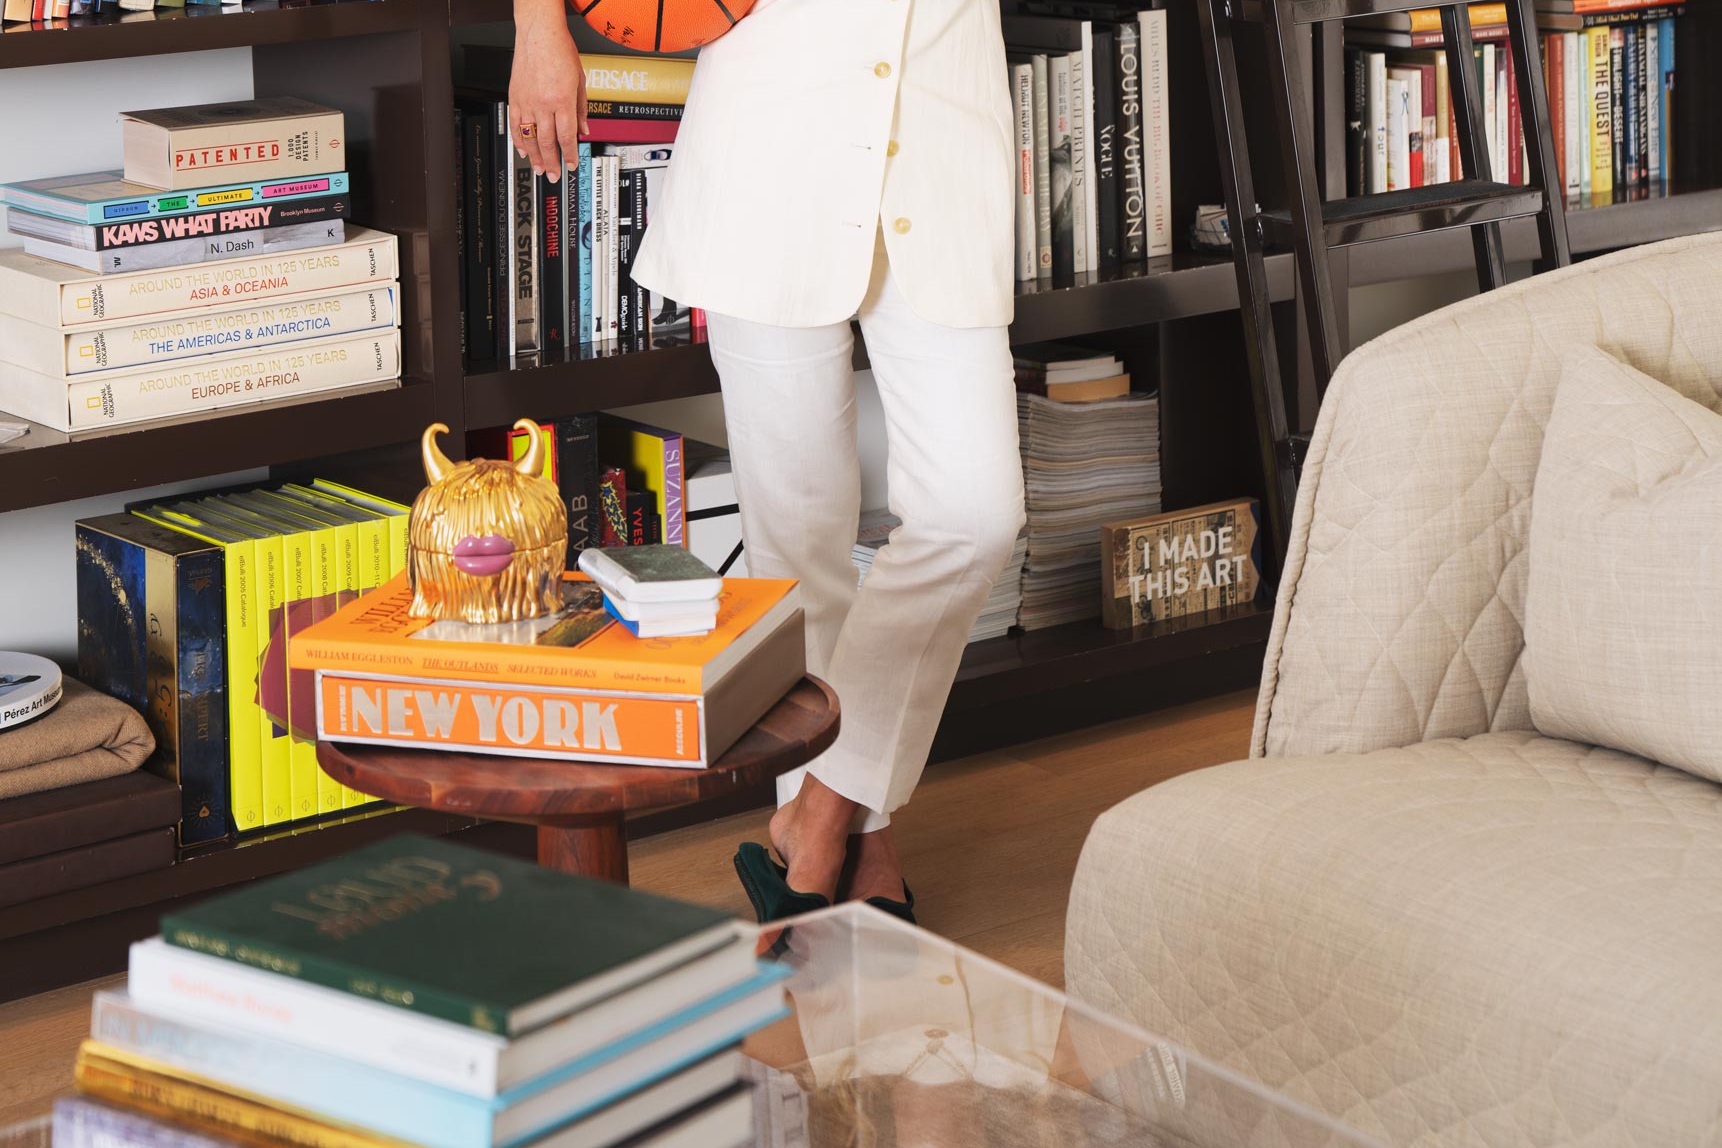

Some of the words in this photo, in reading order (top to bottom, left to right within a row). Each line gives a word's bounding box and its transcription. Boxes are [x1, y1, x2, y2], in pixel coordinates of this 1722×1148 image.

[586, 71, 649, 91] VERSACE
[1120, 41, 1139, 116] LOUIS
[1595, 60, 1610, 87] THE
[1594, 91, 1611, 138] QUEST
[176, 143, 280, 167] PATENTED
[1100, 124, 1115, 179] VOGUE
[208, 193, 243, 202] ULTIMATE
[291, 183, 319, 192] MUSEUM
[517, 168, 532, 227] BACK
[1123, 125, 1144, 237] VUITTON
[102, 218, 159, 247] KAWS
[160, 212, 214, 240] WHAT
[220, 206, 273, 232] PARTY
[281, 208, 308, 218] Brooklyn
[309, 206, 325, 215] Museum
[546, 196, 558, 258] INDOCHINE
[211, 244, 222, 254] N.
[226, 240, 254, 252] Dash
[129, 280, 183, 295] AROUND
[185, 275, 210, 288] THE
[212, 267, 258, 284] WORLD
[260, 266, 274, 278] IN
[278, 262, 297, 274] 125
[299, 256, 340, 272] YEARS
[518, 235, 532, 299] STAGE
[190, 287, 218, 300] ASIA
[222, 286, 230, 296] &
[234, 277, 288, 294] OCEANIA
[149, 342, 174, 354] THE
[177, 331, 241, 351] AMERICAS
[245, 330, 253, 340] &
[257, 318, 331, 338] ANTARCTICA
[192, 383, 241, 400] EUROPE
[244, 380, 253, 390] &
[256, 372, 300, 387] AFRICA
[633, 508, 643, 545] YVES
[1143, 542, 1150, 570] I
[1159, 526, 1233, 566] MADE
[1130, 568, 1190, 603] THIS
[1196, 554, 1248, 591] ART
[306, 649, 350, 662] WILLIAM
[351, 653, 413, 665] EGGLESTON
[422, 657, 442, 669] THE
[507, 664, 558, 676] SELECTED
[560, 666, 597, 678] WORKS
[4, 707, 29, 721] Pérez
[31, 699, 42, 711] Art
[351, 686, 461, 739] NEW
[471, 694, 622, 751] YORK
